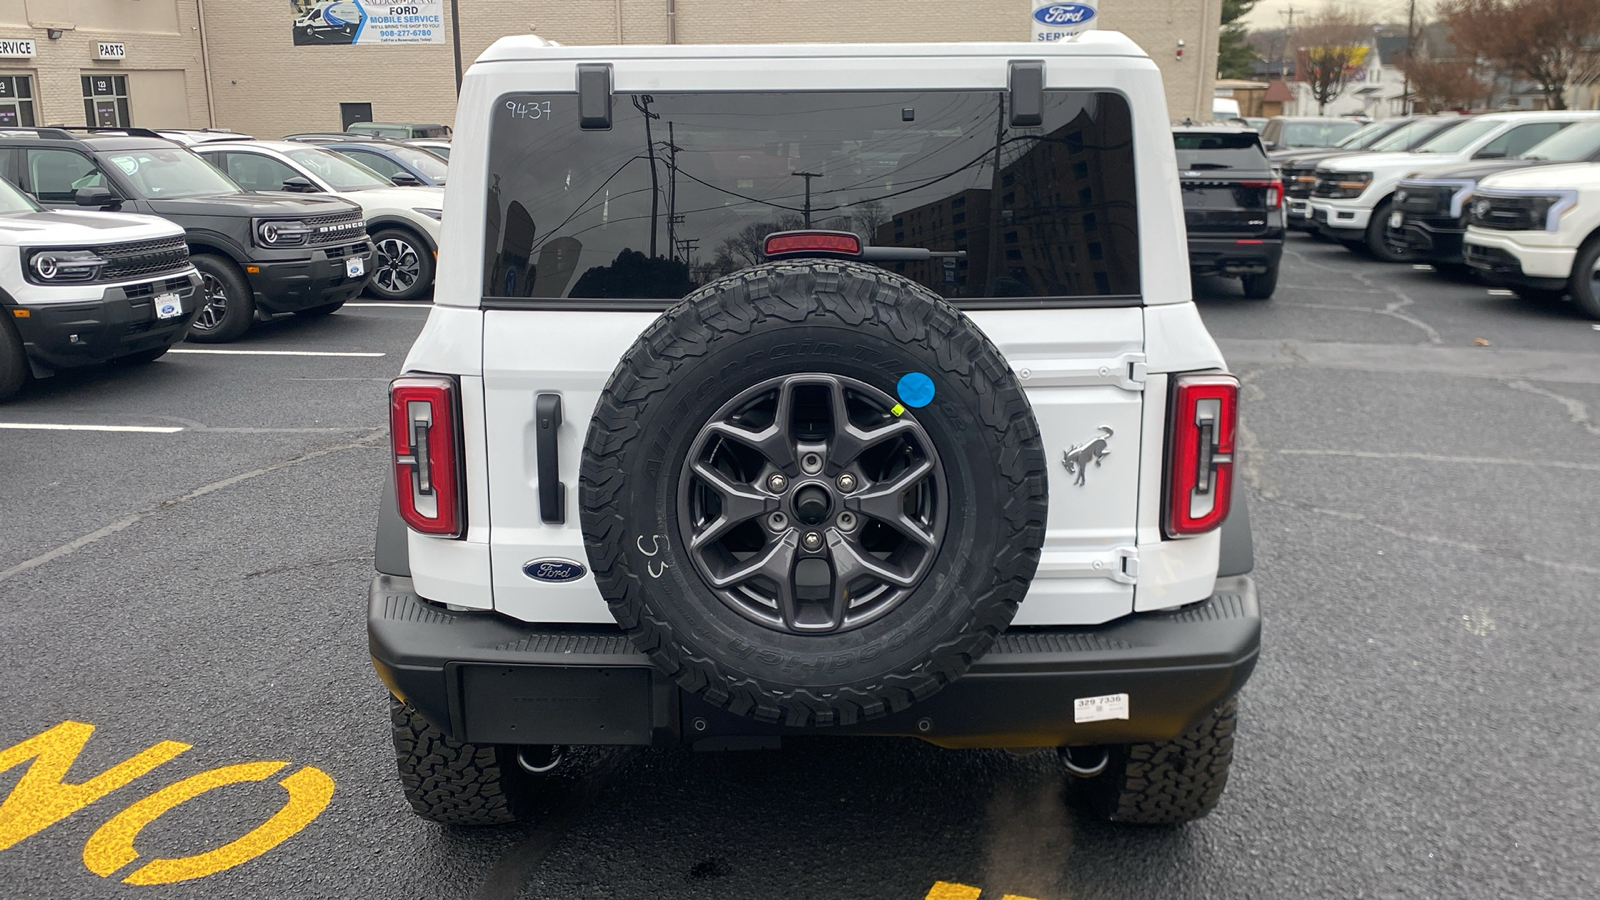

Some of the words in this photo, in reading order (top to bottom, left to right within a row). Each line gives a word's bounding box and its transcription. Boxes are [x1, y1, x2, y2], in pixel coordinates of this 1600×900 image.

[389, 6, 419, 15] FORD
[1044, 5, 1085, 23] Ford
[370, 16, 402, 24] MOBILE
[403, 15, 440, 23] SERVICE
[380, 29, 432, 37] 908-277-6780
[99, 44, 124, 56] PARTS
[97, 80, 107, 88] 123
[505, 100, 552, 121] 9437
[319, 221, 363, 233] BRONCO
[536, 562, 572, 578] Ford
[1078, 698, 1096, 707] 329
[1099, 696, 1122, 704] 7336
[0, 719, 336, 887] NO
